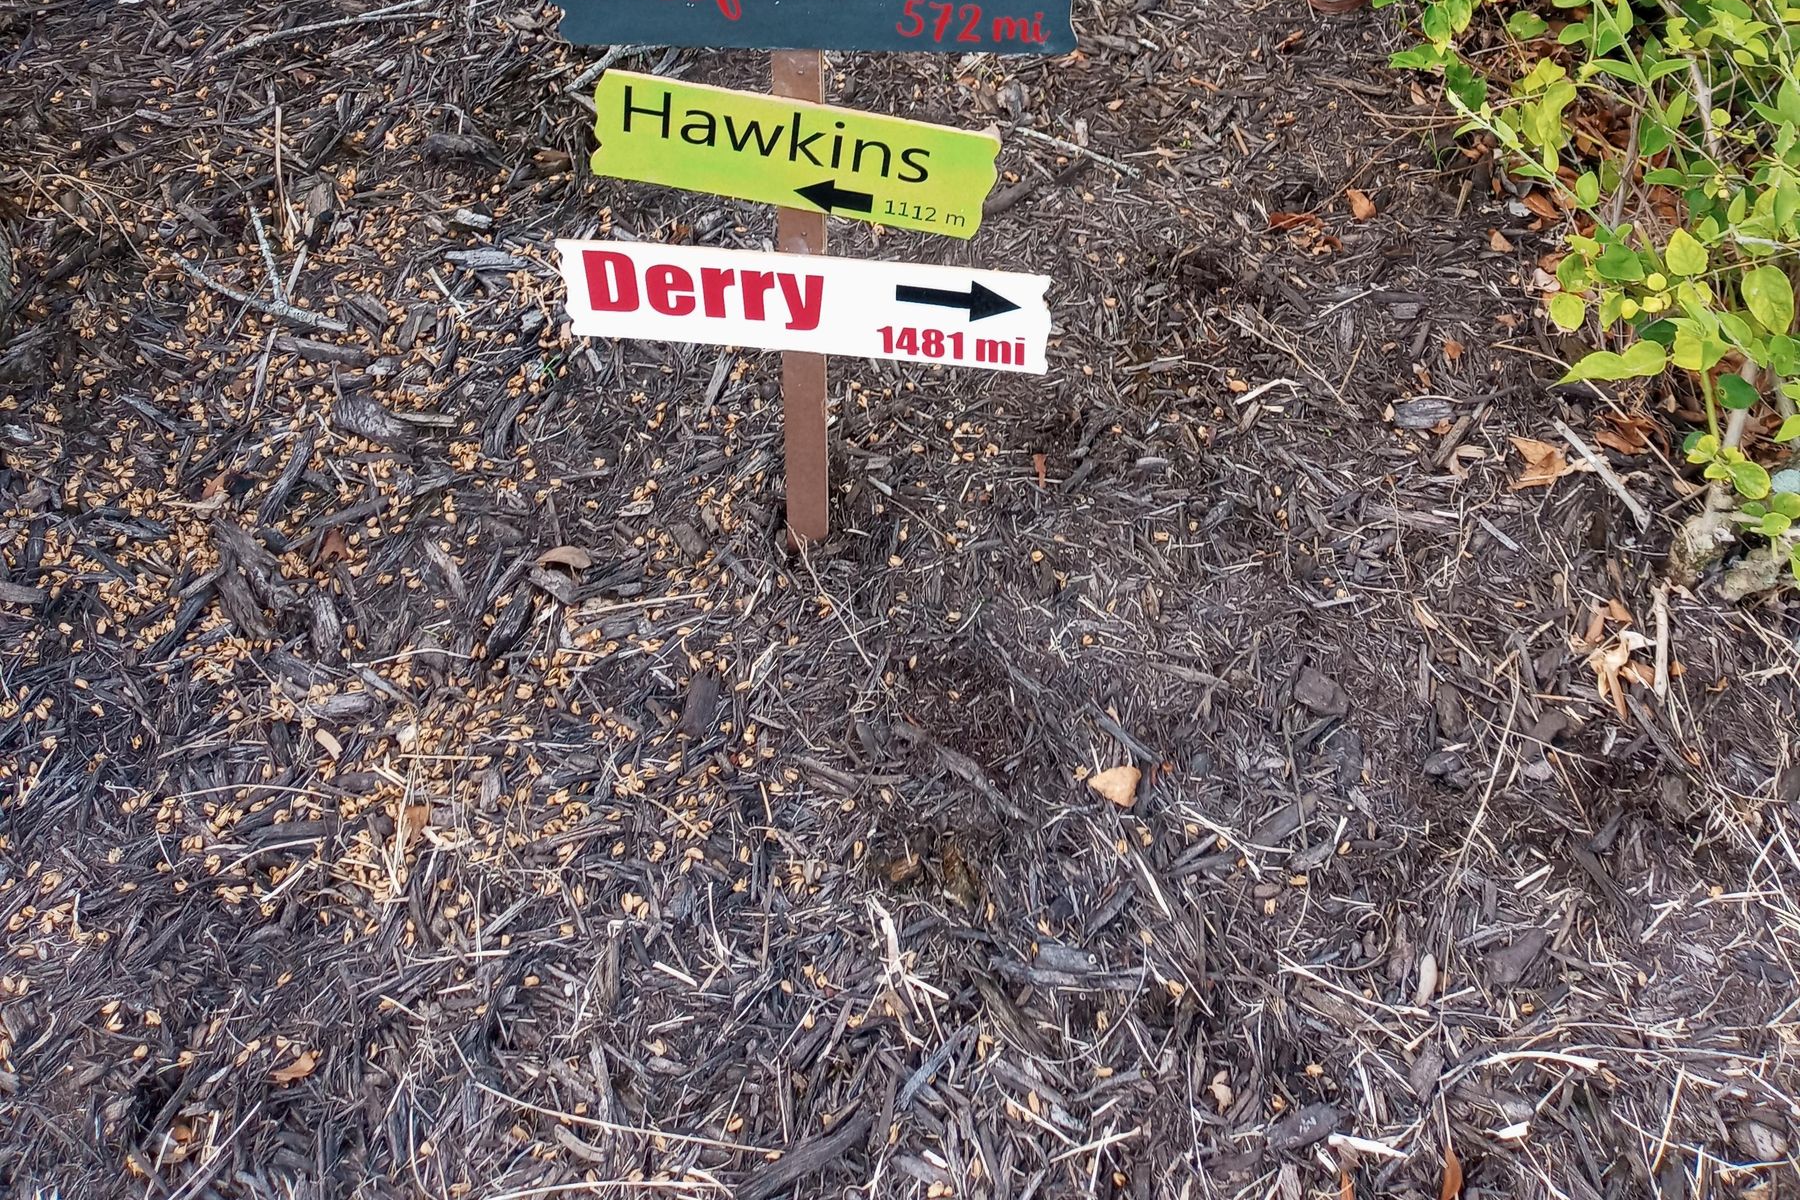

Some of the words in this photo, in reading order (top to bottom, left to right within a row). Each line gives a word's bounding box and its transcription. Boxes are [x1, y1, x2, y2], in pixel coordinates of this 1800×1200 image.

[991, 11, 1049, 44] mi
[622, 85, 931, 184] Hawkins
[885, 199, 937, 223] 1112
[945, 212, 966, 227] m
[581, 249, 825, 331] Derry
[876, 325, 964, 359] 1481
[974, 336, 1026, 366] mi
